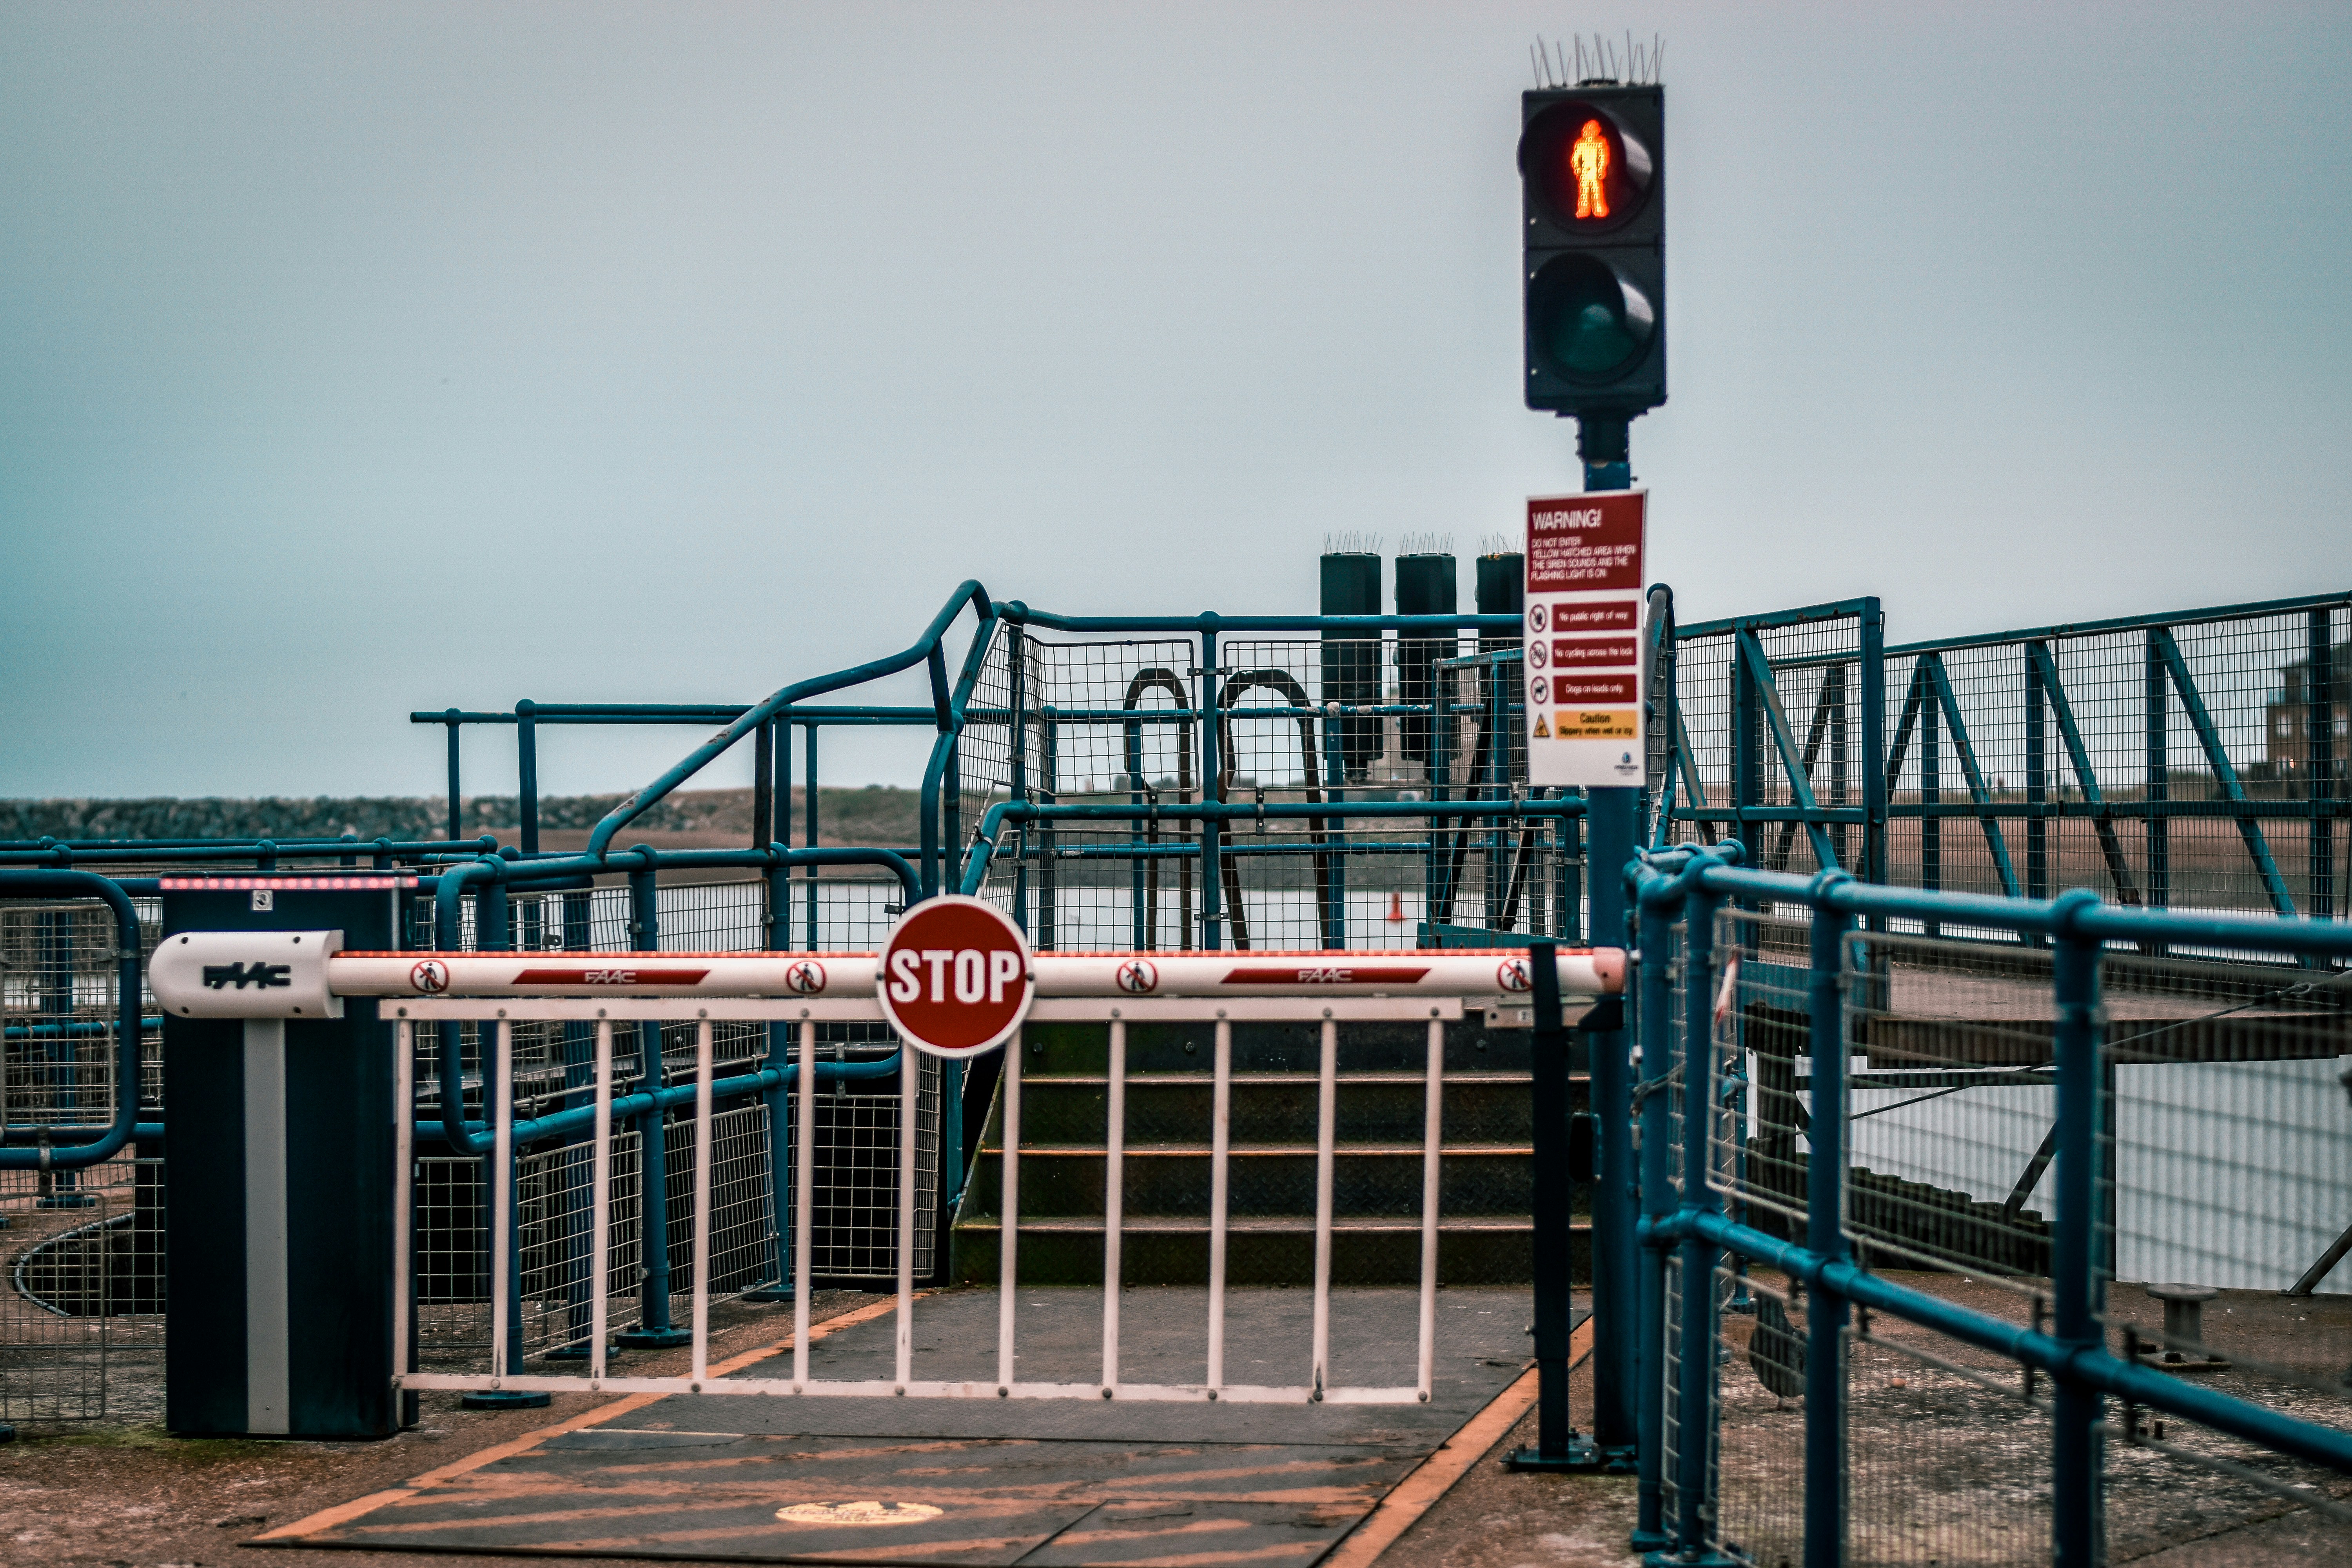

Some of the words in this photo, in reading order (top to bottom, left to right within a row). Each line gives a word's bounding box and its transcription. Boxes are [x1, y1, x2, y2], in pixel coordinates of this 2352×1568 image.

[1532, 509, 1602, 530] WARNING!
[1531, 538, 1543, 548] DO
[1543, 537, 1557, 548] NOT
[1559, 536, 1581, 547] ENTER
[1532, 549, 1559, 559] YELLOW
[1560, 547, 1592, 557] HATCHED
[1593, 546, 1613, 556] AREA
[1613, 544, 1636, 555] WHEN
[1532, 560, 1544, 570] THE
[1546, 559, 1566, 569] SIREN
[1568, 557, 1597, 568] SOUNDS
[1597, 557, 1613, 567] AND
[1614, 556, 1628, 566] THE
[1531, 571, 1565, 580] FLASHING
[1566, 569, 1586, 579] LIGHT
[1586, 568, 1594, 578] IS
[1594, 568, 1607, 578] ON
[1559, 612, 1568, 621] No
[1570, 612, 1588, 622] public
[1590, 611, 1604, 622] right
[1606, 610, 1613, 619] of
[1555, 648, 1564, 657] No
[1565, 648, 1586, 659] cycling
[1608, 647, 1618, 656] the
[1620, 646, 1633, 656] lock
[1566, 684, 1582, 696] Dogs
[1592, 684, 1608, 693] leads
[1609, 683, 1624, 695] only
[1580, 712, 1611, 724] Caution
[1559, 726, 1582, 736] Slippery
[1584, 726, 1600, 735] when
[1602, 726, 1613, 735] wet
[1624, 726, 1632, 735] icy
[584, 970, 636, 983] FAAC
[890, 949, 1020, 1004] STOP
[1298, 968, 1352, 982] FAAC
